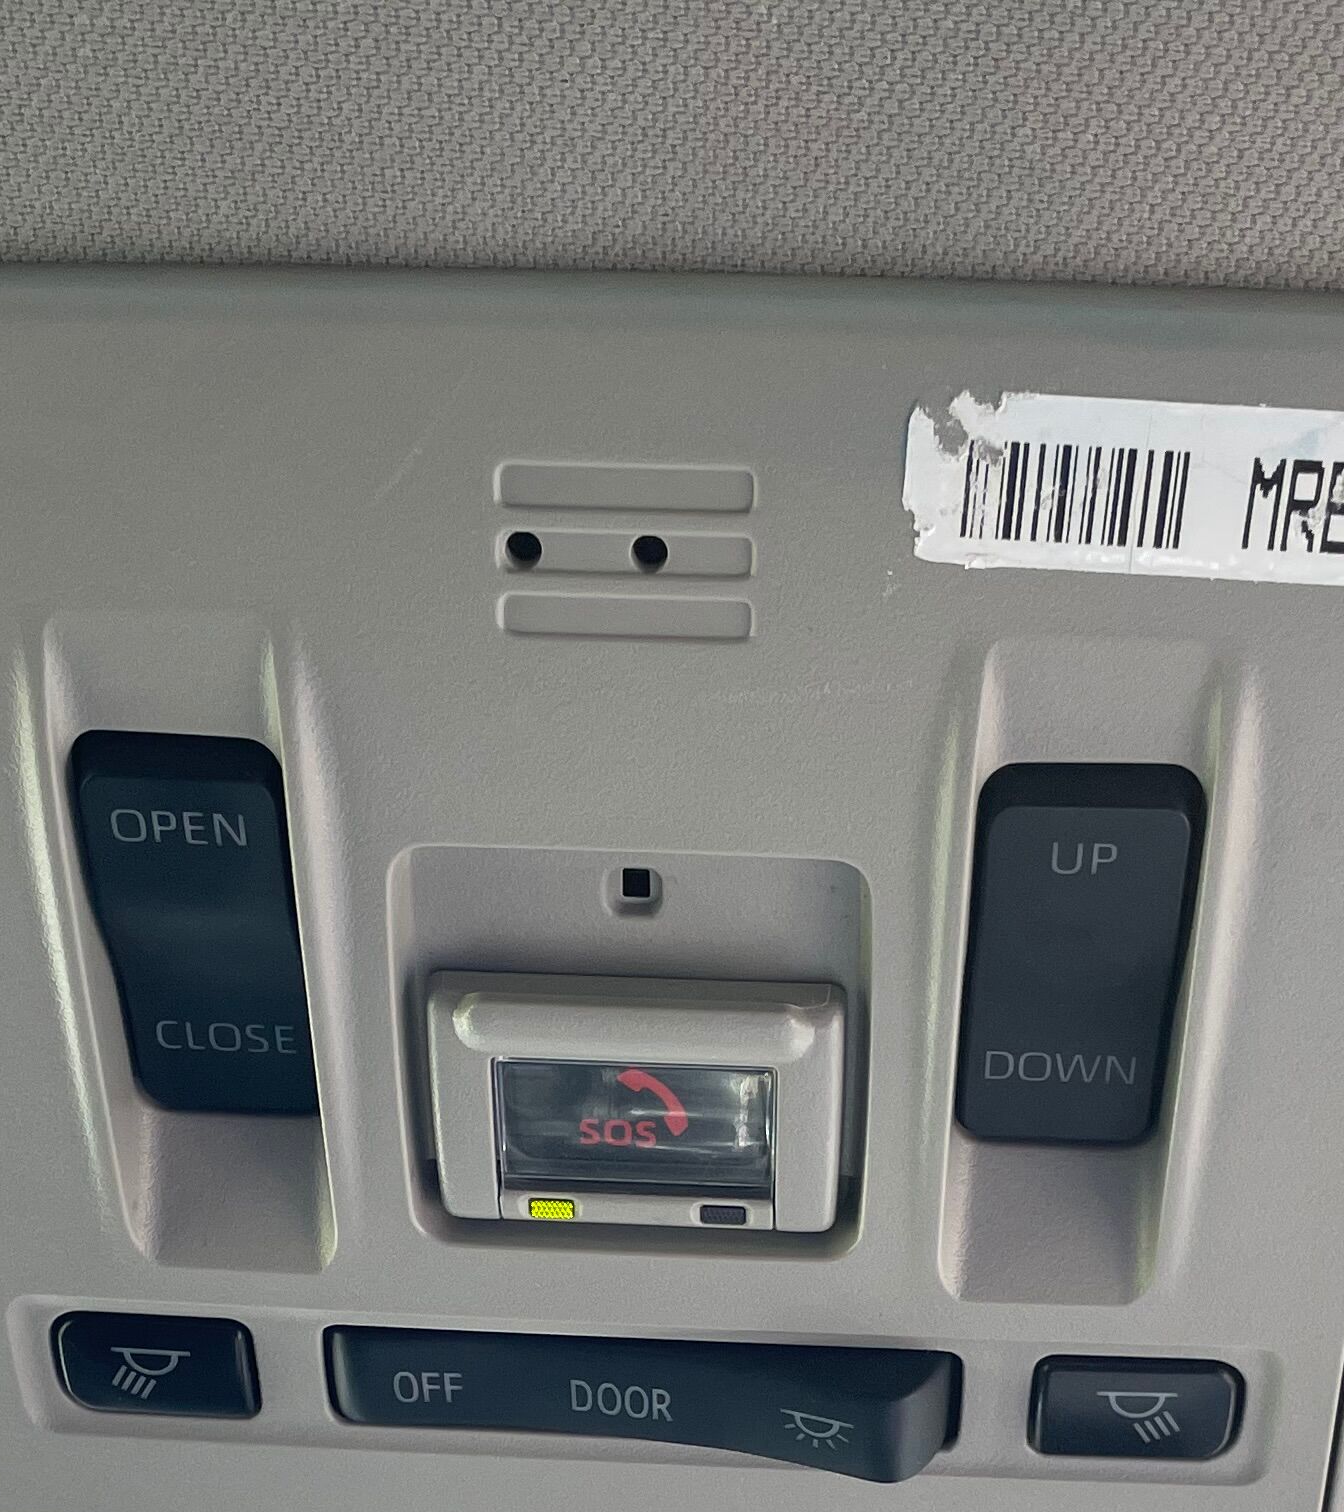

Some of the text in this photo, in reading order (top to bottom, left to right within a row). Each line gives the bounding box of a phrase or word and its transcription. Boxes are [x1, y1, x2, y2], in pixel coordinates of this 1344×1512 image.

[109, 808, 249, 848] OPEN
[1050, 841, 1118, 876] UP
[156, 1019, 297, 1055] CLOSE
[983, 1050, 1137, 1085] DOWN
[578, 1118, 657, 1149] SOS
[392, 1370, 674, 1423] OFF DOOR
